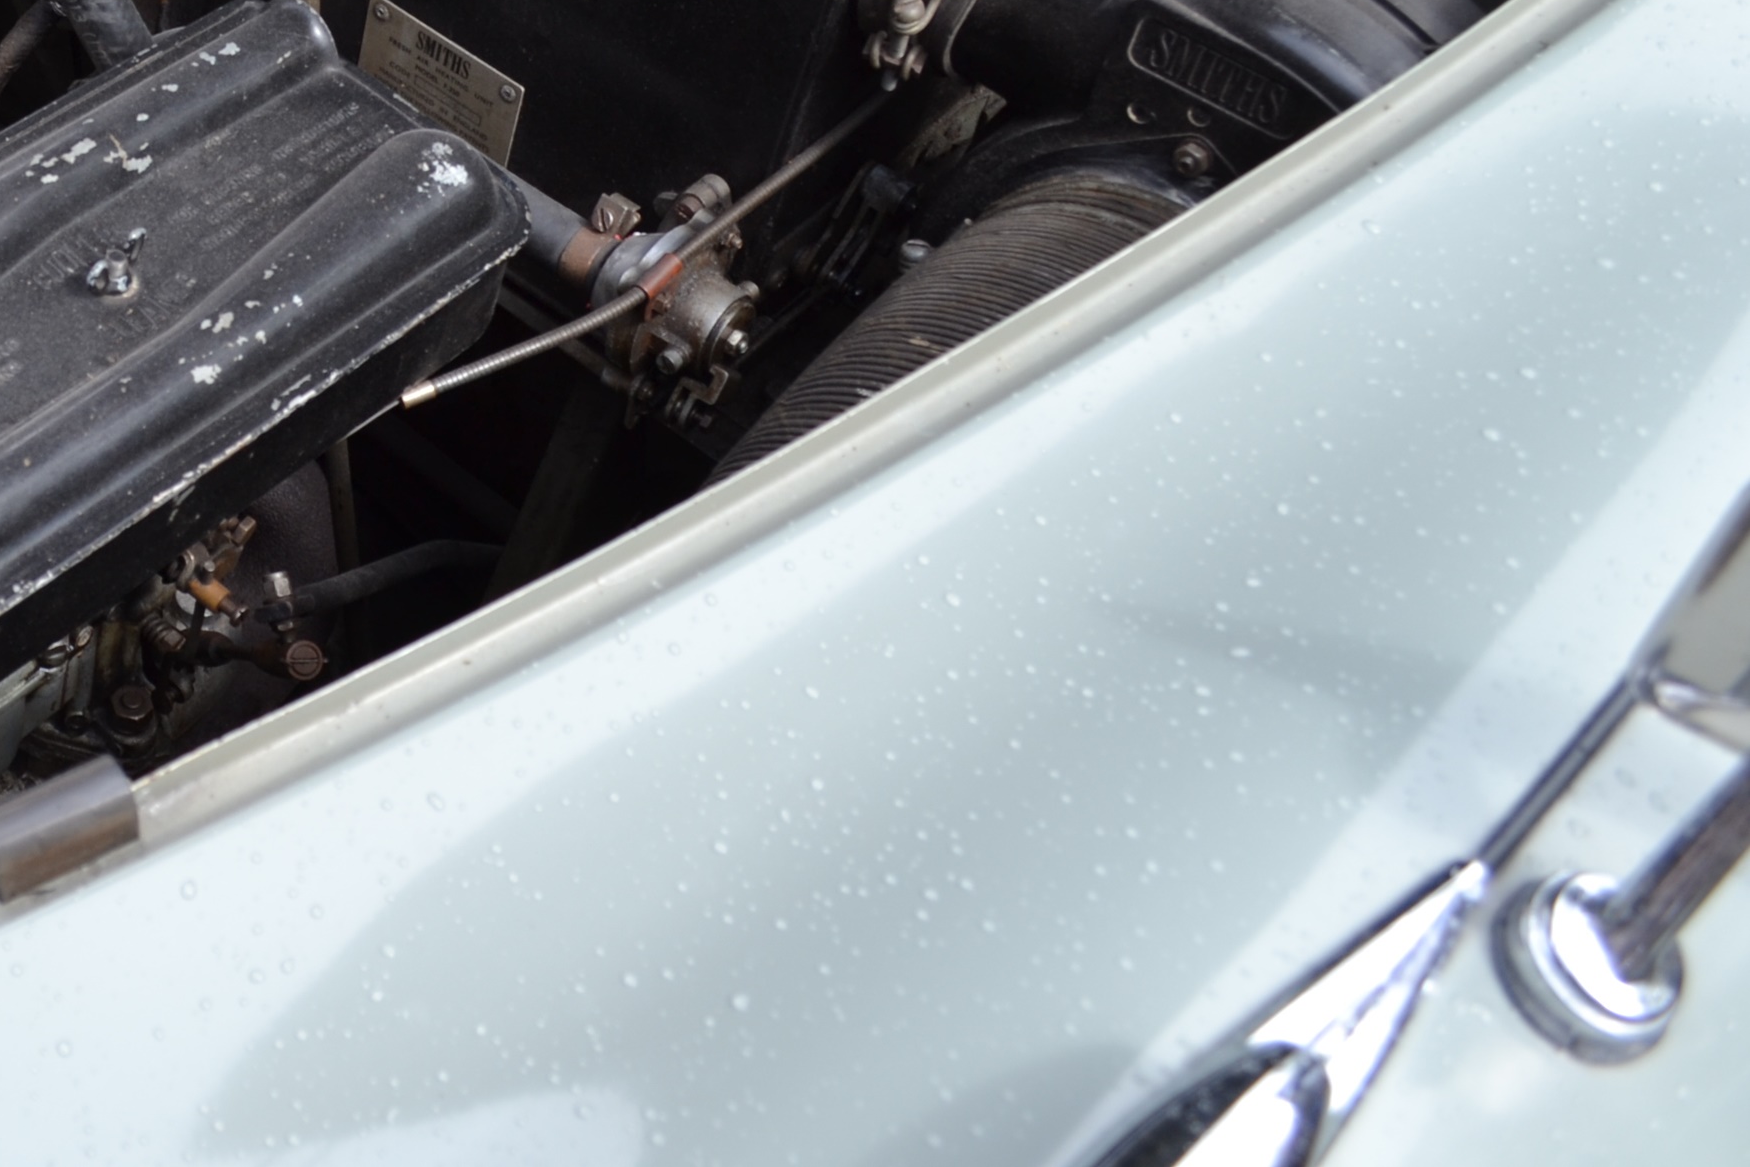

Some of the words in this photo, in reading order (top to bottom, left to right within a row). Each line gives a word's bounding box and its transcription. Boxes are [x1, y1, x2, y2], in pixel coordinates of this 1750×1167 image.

[388, 35, 411, 54] FRESH
[416, 54, 429, 66] AIR
[474, 93, 494, 107] UNIT
[416, 31, 471, 79] SMITHS
[1150, 29, 1287, 124] SMITHS
